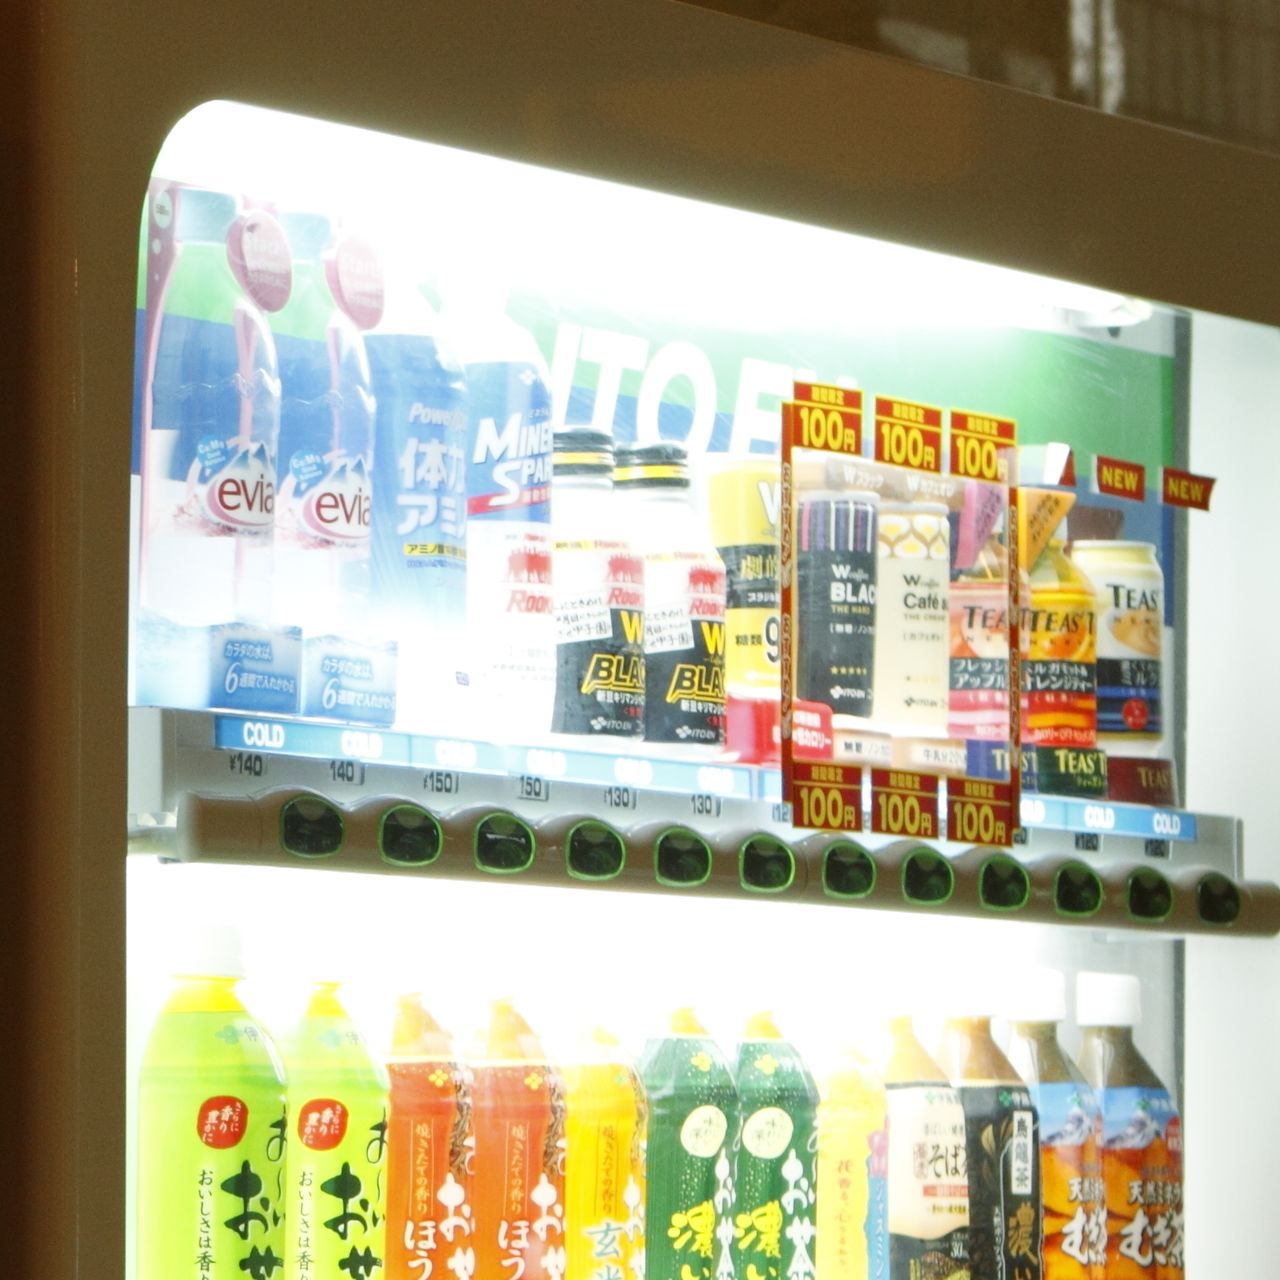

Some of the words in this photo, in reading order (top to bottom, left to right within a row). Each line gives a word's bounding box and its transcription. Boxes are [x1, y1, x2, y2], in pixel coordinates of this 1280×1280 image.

[800, 407, 856, 453] 100円
[880, 421, 935, 470] 100円
[1100, 465, 1138, 492] NEW
[1167, 477, 1207, 503] NEW
[242, 722, 285, 748] COLD
[800, 787, 856, 829] 100円
[878, 794, 932, 835] 100円
[954, 802, 1006, 843] 100円
[1084, 804, 1115, 829] COLD
[1153, 812, 1181, 835] COLD
